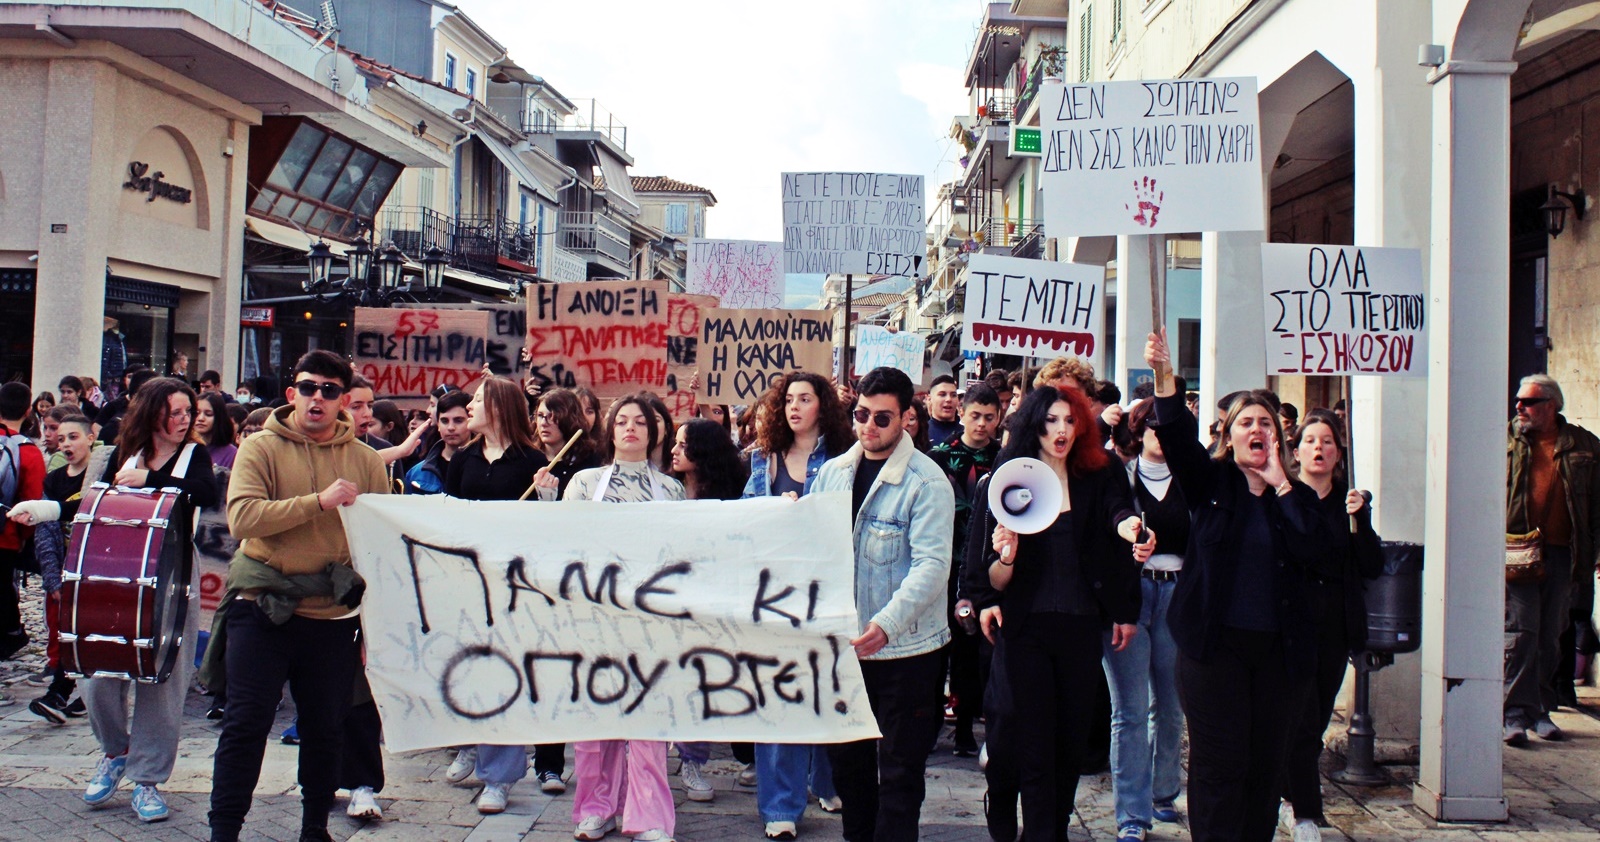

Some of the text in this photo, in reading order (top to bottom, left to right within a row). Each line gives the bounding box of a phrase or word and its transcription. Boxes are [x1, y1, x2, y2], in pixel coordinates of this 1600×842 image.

[1056, 80, 1239, 121] ΔΕΝ ΣΩΠΑΙΝΩ
[1043, 123, 1254, 173] ΔΕΝ ΣΑΣ ΚΑΝΩ ΤΗΝ ΧΑΡΗ
[884, 174, 921, 199] ΞΑΝΑ
[783, 226, 802, 250] ΔΕΝ
[1309, 247, 1369, 289] ΟΛΑ
[538, 284, 658, 321] Η ΑΝΟΙΞΗ
[971, 271, 1096, 329] ΤΕΜΠΗ
[1270, 288, 1424, 332] ΣΤΟ ΠΕΡΙΠΟΥ
[395, 312, 439, 338] 57
[704, 317, 789, 343] ΜΑΛΛΟΝ
[357, 331, 485, 367] ΕΙΣΙΤΗΡΙΑ
[713, 345, 728, 371] Η
[737, 342, 802, 371] ΚΑΚΙΑ
[1278, 332, 1414, 373] ΞΕΣΗΚΩΣΟΥ
[577, 358, 667, 387] ΤΕΜΠΗ
[707, 372, 723, 397] Η
